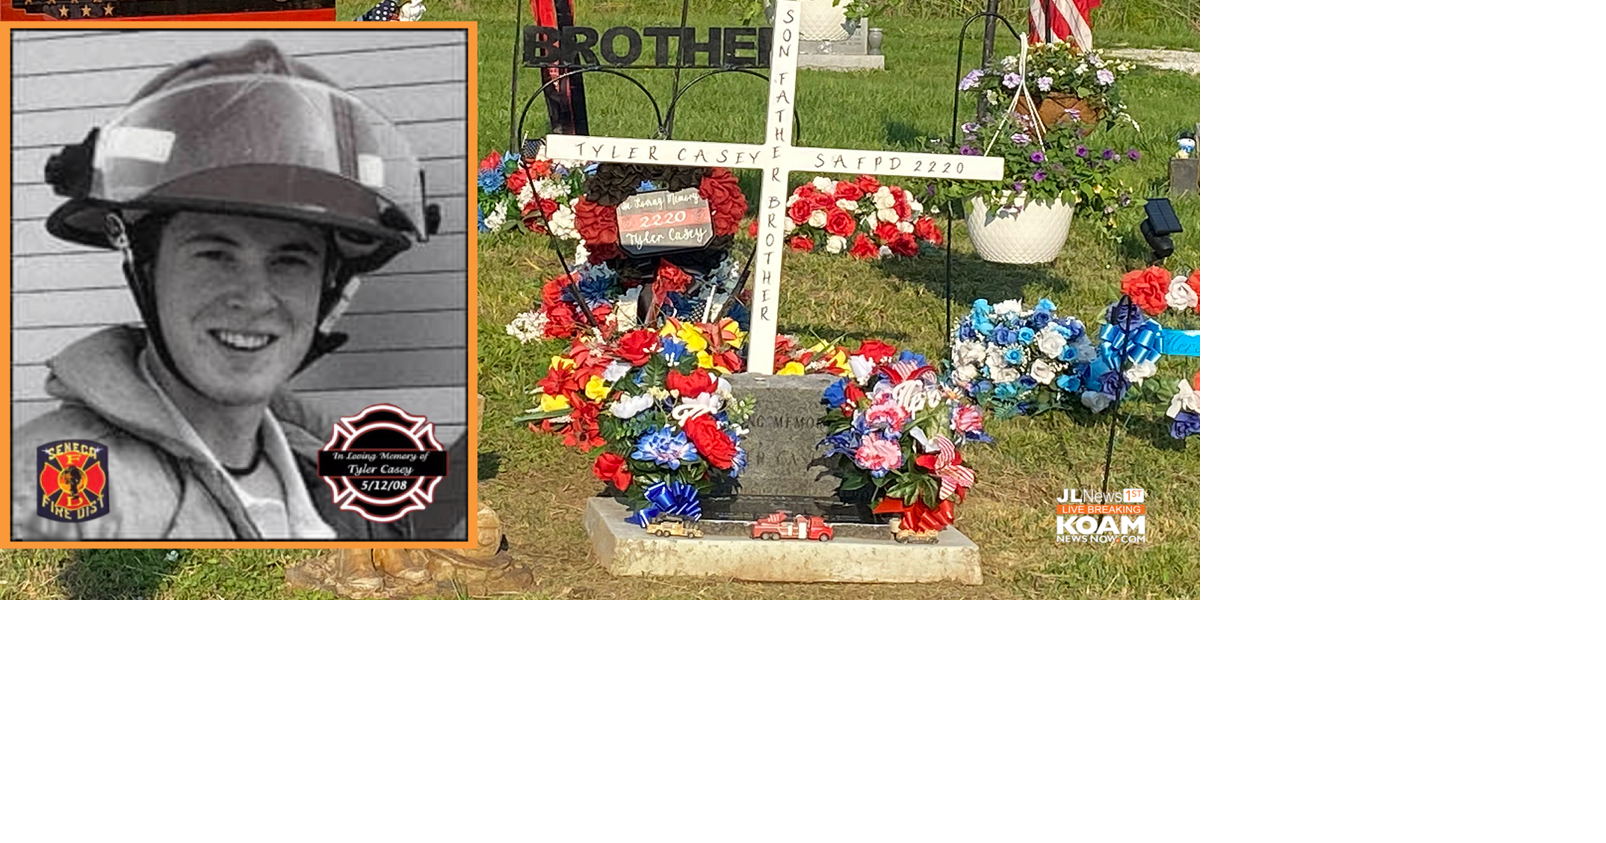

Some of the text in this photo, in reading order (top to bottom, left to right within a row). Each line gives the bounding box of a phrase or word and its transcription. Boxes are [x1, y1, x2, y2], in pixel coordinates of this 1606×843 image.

[576, 143, 761, 165] TYLER CASEY
[814, 153, 965, 174] SAFPD 2220
[760, 9, 795, 322] SON FATHER BROTHER
[639, 210, 687, 228] 2220
[625, 228, 708, 250] Tyler Casey
